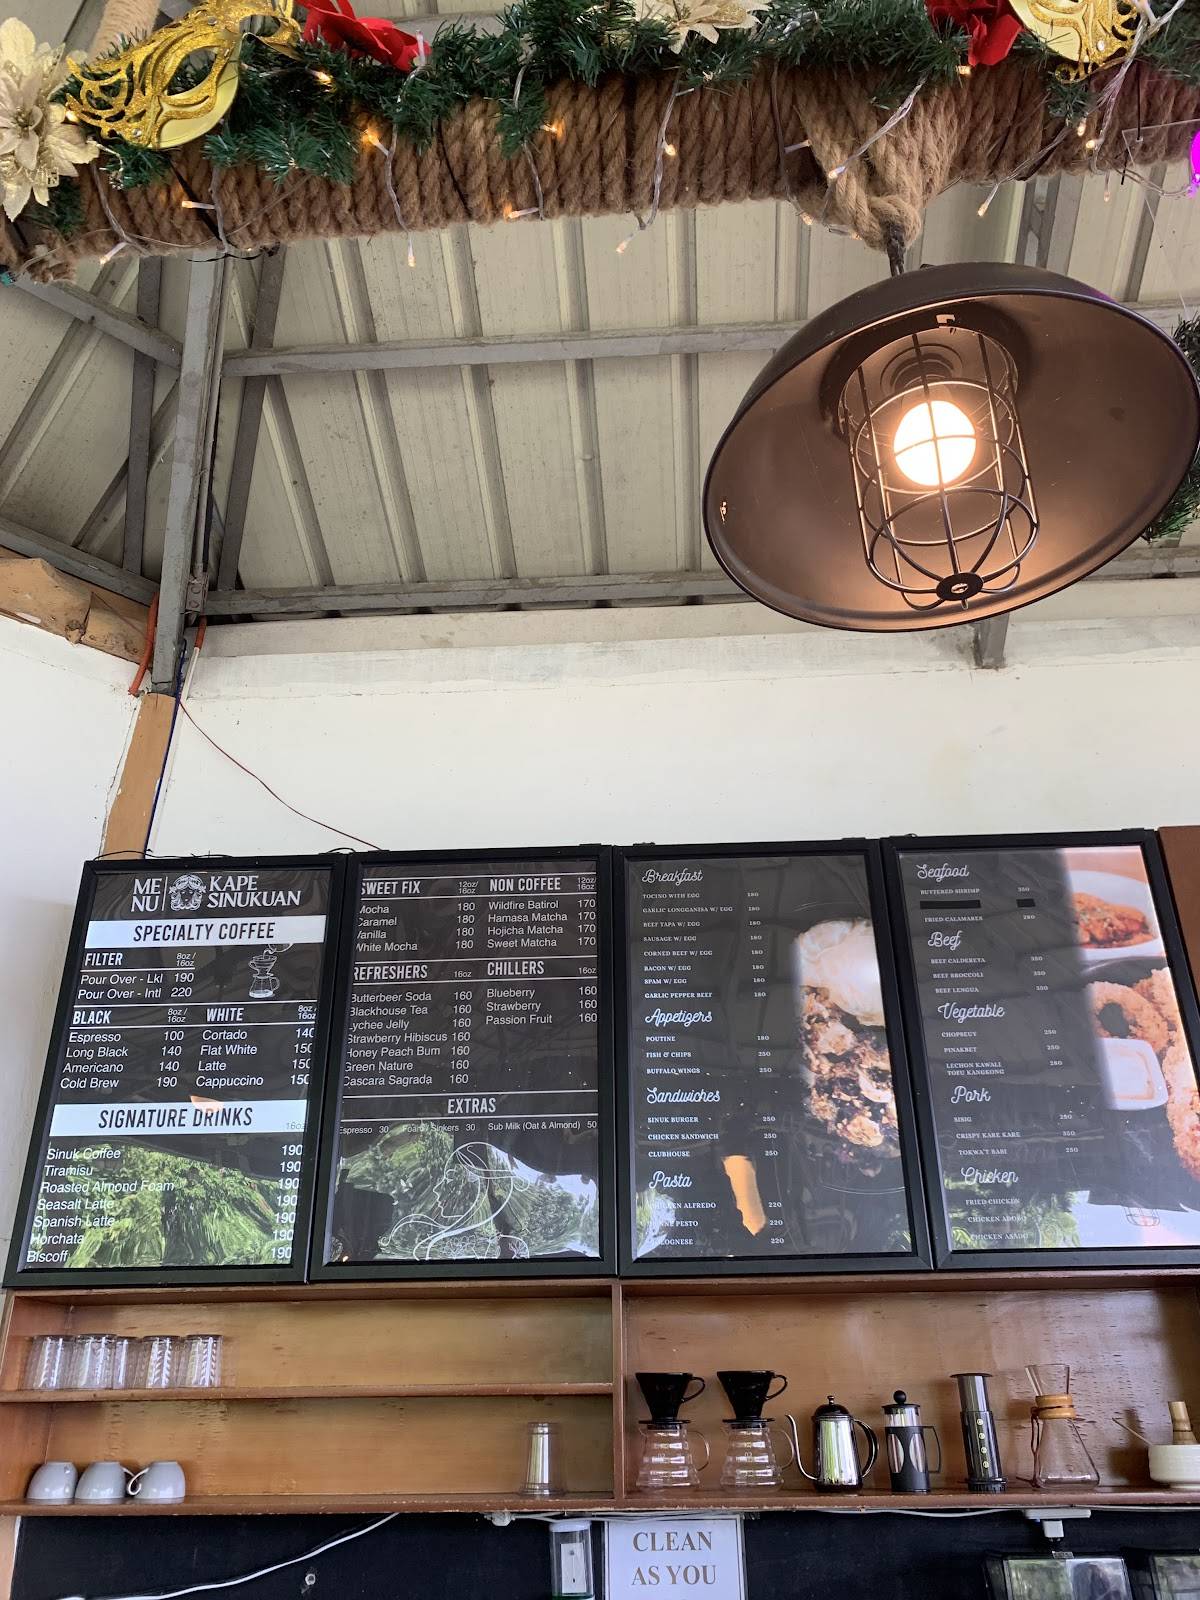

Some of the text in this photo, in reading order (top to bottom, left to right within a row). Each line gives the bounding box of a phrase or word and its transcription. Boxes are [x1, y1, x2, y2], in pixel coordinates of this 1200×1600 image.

[642, 868, 703, 886] Breakfast
[917, 863, 969, 882] Seafood
[134, 878, 162, 895] ME
[209, 875, 258, 891] KAPE
[402, 881, 420, 893] FIX
[490, 878, 561, 891] NON COFFEE
[131, 897, 159, 912] NU
[207, 890, 301, 908] SINUKUAN
[489, 899, 595, 910] Wildfire Batirol 170
[458, 902, 475, 911] 180
[457, 915, 474, 924] 180
[488, 912, 596, 923] Hamasa Matcha 170
[133, 922, 275, 942] SPECIALTY COFFEE
[456, 927, 474, 936] 180
[488, 924, 596, 936] Hojicha Matcha 170
[385, 940, 473, 951] Mocha 180
[487, 937, 596, 948] Sweet Matcha 170
[928, 931, 962, 950] Beef
[84, 953, 123, 967] FILTER
[487, 961, 544, 976] CHILLERS
[81, 975, 107, 985] Pour
[109, 974, 136, 984] Over
[174, 972, 194, 983] 190
[78, 989, 104, 1000] Pour
[107, 989, 134, 999] Over
[171, 987, 192, 997] 220
[405, 992, 472, 1001] Soda 160
[487, 986, 597, 999] Blueberry 160
[410, 1005, 472, 1014] Tea 160
[487, 1000, 597, 1012] Strawberry 160
[938, 1002, 1005, 1023] Vegetable
[73, 1011, 111, 1024] BLACK
[207, 1008, 244, 1021] WHITE
[486, 1013, 597, 1025] Passion Fruit 160
[645, 1008, 712, 1027] Appetizers
[386, 1019, 471, 1030] Jelly 160
[69, 1031, 184, 1044] Espresso 100
[203, 1029, 247, 1041] Cortado
[404, 1032, 447, 1042] Hibiscus
[452, 1032, 470, 1041] 160
[66, 1046, 181, 1059] Long Black 140
[200, 1044, 257, 1056] Flat White
[381, 1046, 470, 1056] Peach Bum 160
[63, 1061, 179, 1073] Americano 140
[198, 1060, 226, 1071] Latte
[379, 1060, 469, 1071] Nature 160
[60, 1077, 177, 1088] Cold Brew 190
[196, 1076, 263, 1088] Cappuccino
[389, 1074, 468, 1087] Sagrada 160
[646, 1087, 720, 1104] Sandwiches
[951, 1086, 991, 1103] Pork
[448, 1098, 496, 1114] EXTRAS
[99, 1107, 253, 1129] SIGNATURE DRINKS
[522, 1122, 538, 1130] (Oat
[549, 1121, 580, 1130] Almond)
[47, 1145, 303, 1160] Sinuk Coffee 190
[44, 1161, 301, 1176] Tiramisu 190
[649, 1171, 692, 1189] Pasta
[960, 1167, 1018, 1185] Chicken
[40, 1178, 299, 1193] Roasted Almond Foam 190
[37, 1195, 297, 1210] Seasalt Latte 190
[34, 1212, 296, 1229] Spanish Latte 190
[30, 1229, 294, 1245] Horchata 190
[27, 1247, 292, 1262] Biscoff 190
[632, 1531, 712, 1551] CLEAN
[632, 1565, 716, 1585] AS YOU
